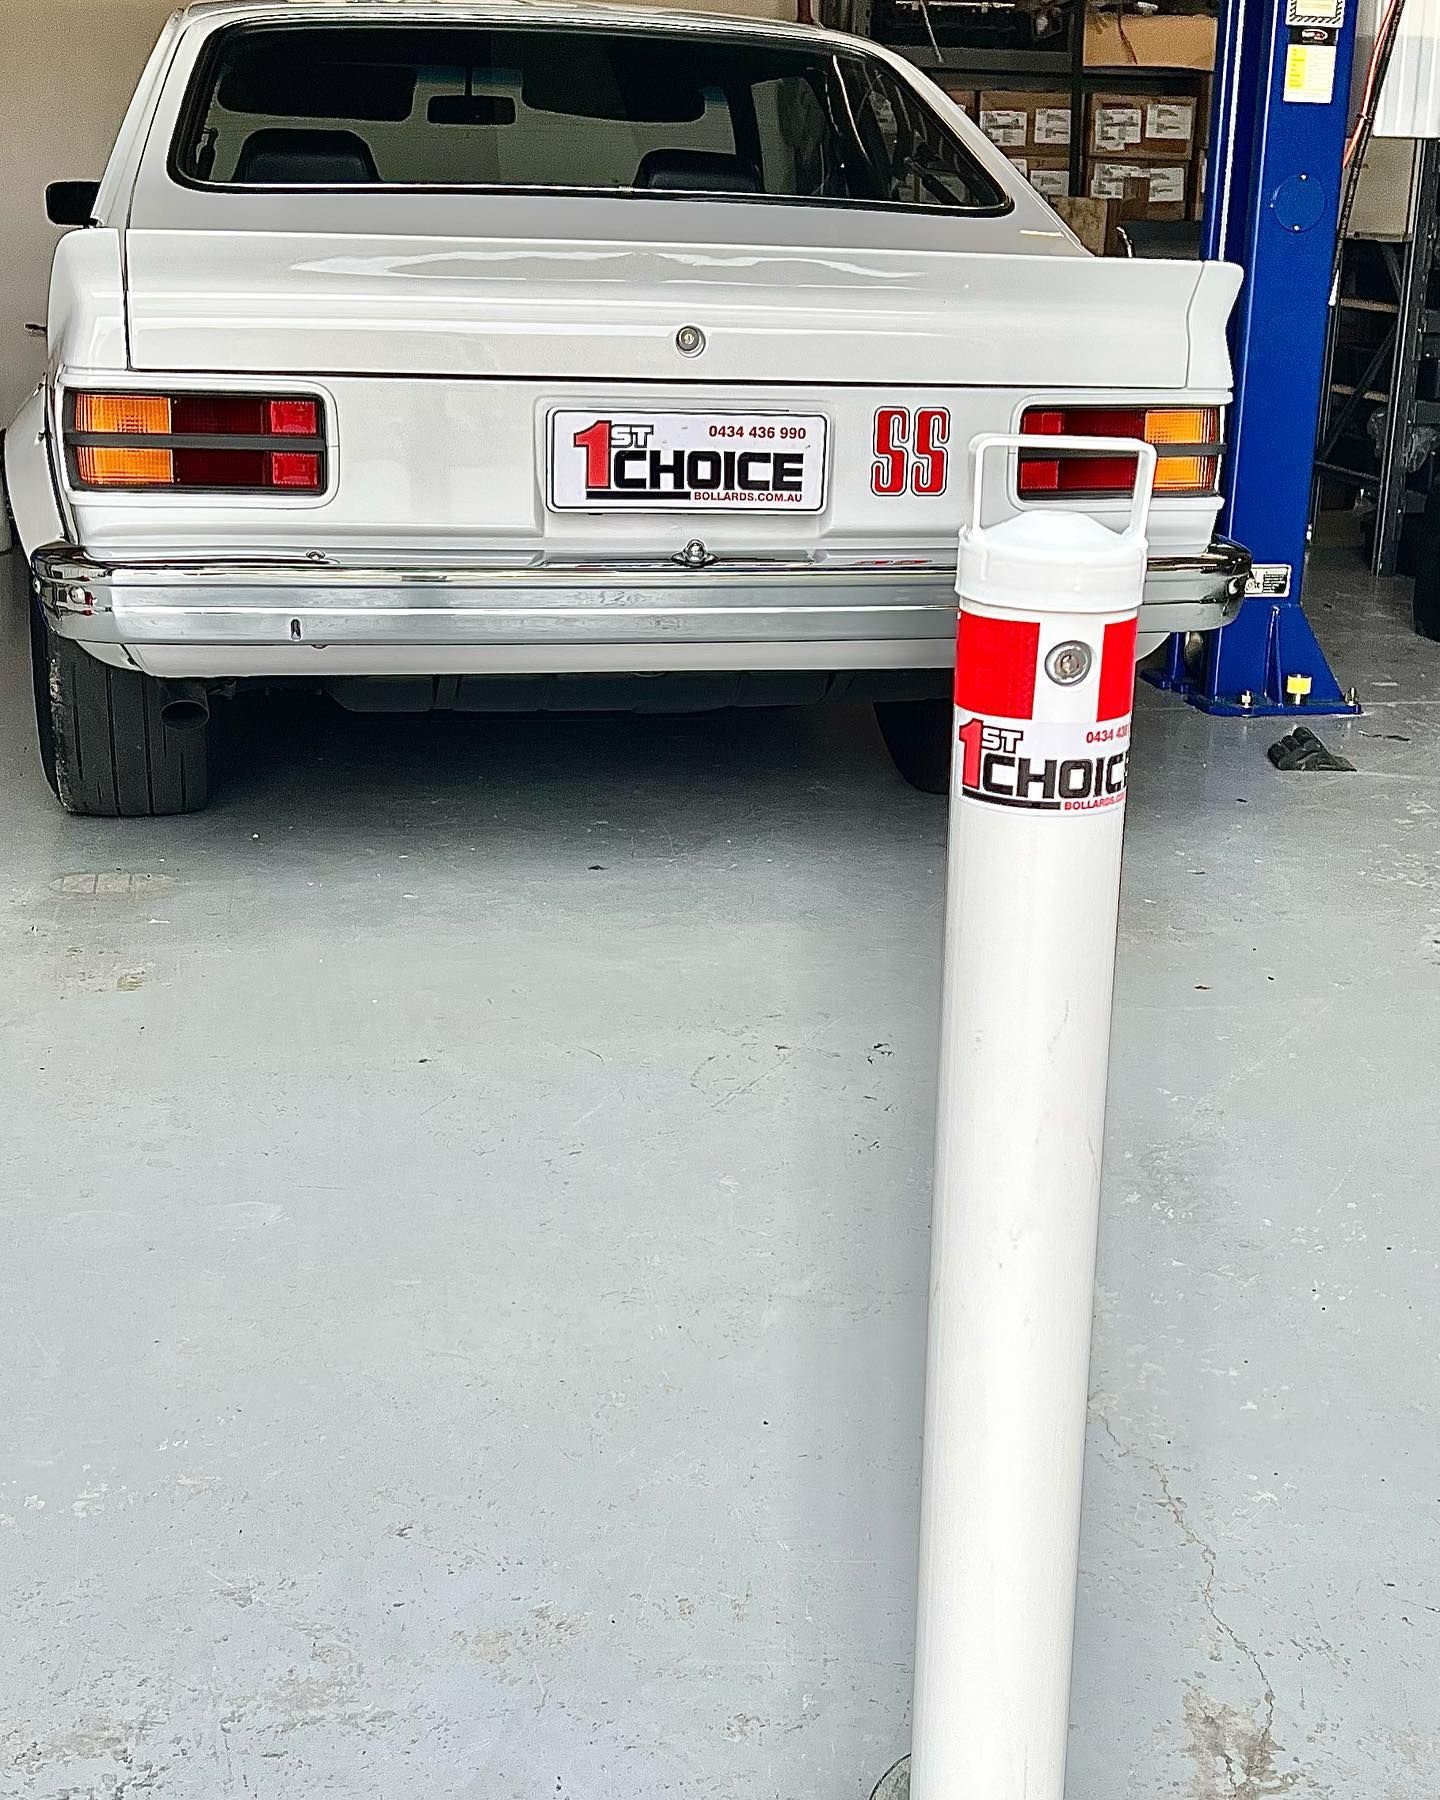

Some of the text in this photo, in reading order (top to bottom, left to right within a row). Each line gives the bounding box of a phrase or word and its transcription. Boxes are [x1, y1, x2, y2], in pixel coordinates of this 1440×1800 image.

[708, 425, 806, 440] 0434 436 990
[573, 419, 654, 490] 1ST
[870, 405, 951, 497] SS
[613, 449, 804, 492] CHOICE
[694, 491, 802, 502] BOLLARDS.COM.AU
[1086, 729, 1113, 744] 0434
[959, 717, 1024, 790] 1ST
[1064, 791, 1126, 811] BOLLARDS.CO
